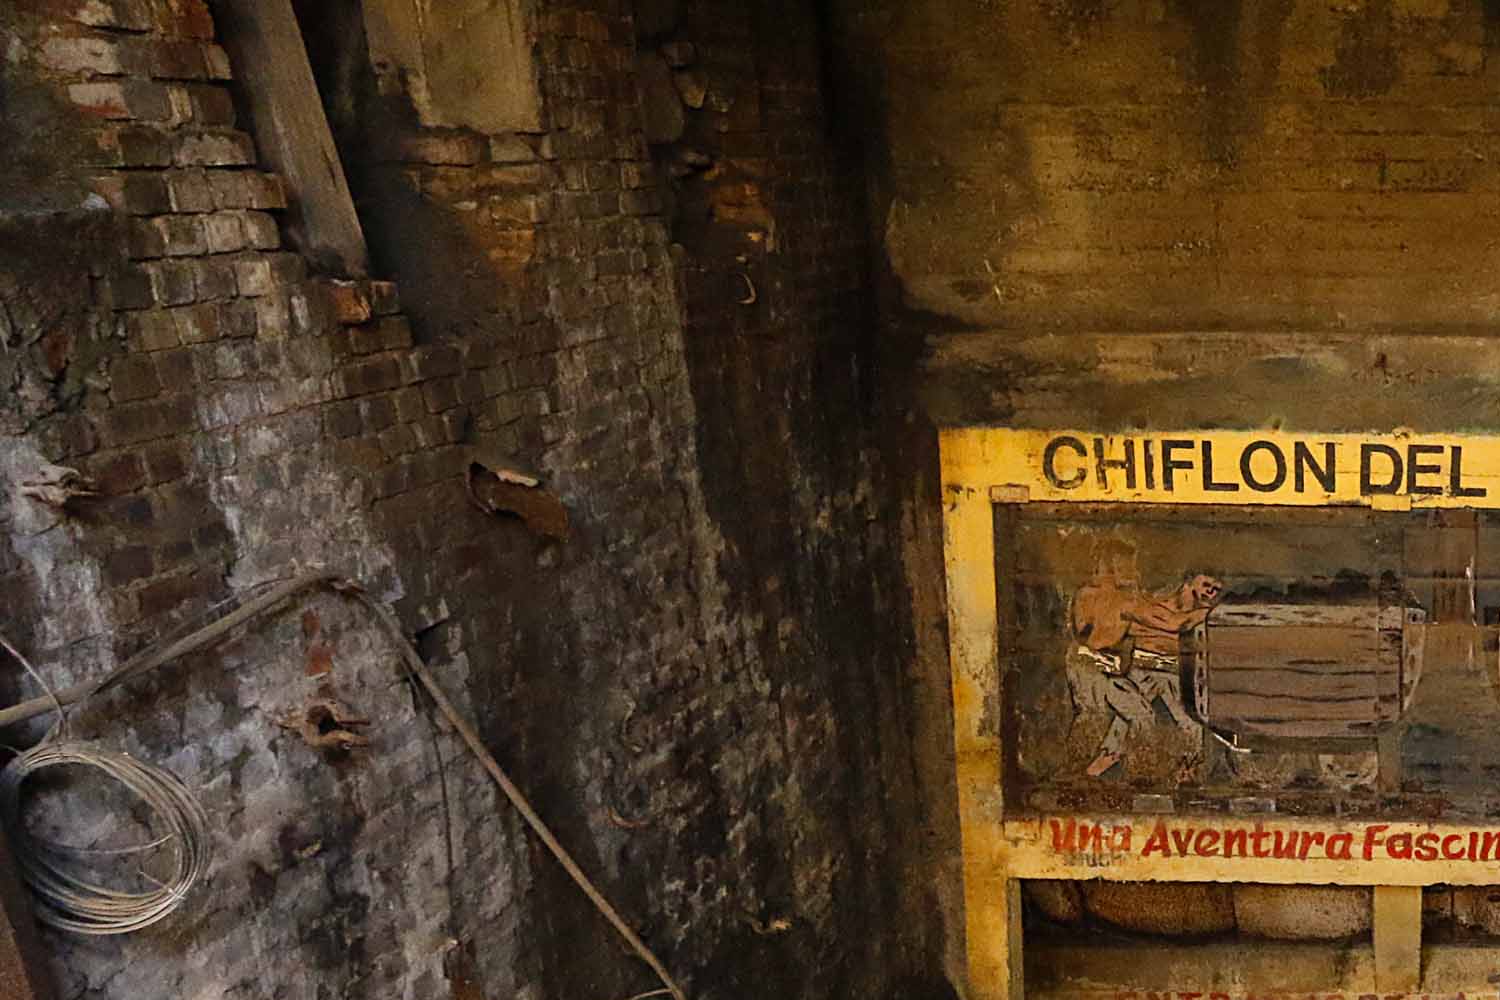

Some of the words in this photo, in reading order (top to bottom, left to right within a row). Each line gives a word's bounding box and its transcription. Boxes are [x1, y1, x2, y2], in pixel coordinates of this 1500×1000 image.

[1043, 436, 1336, 493] CHIFLON
[1360, 443, 1487, 498] DEL
[1049, 816, 1133, 855] Una
[1140, 817, 1354, 861] Aventura
